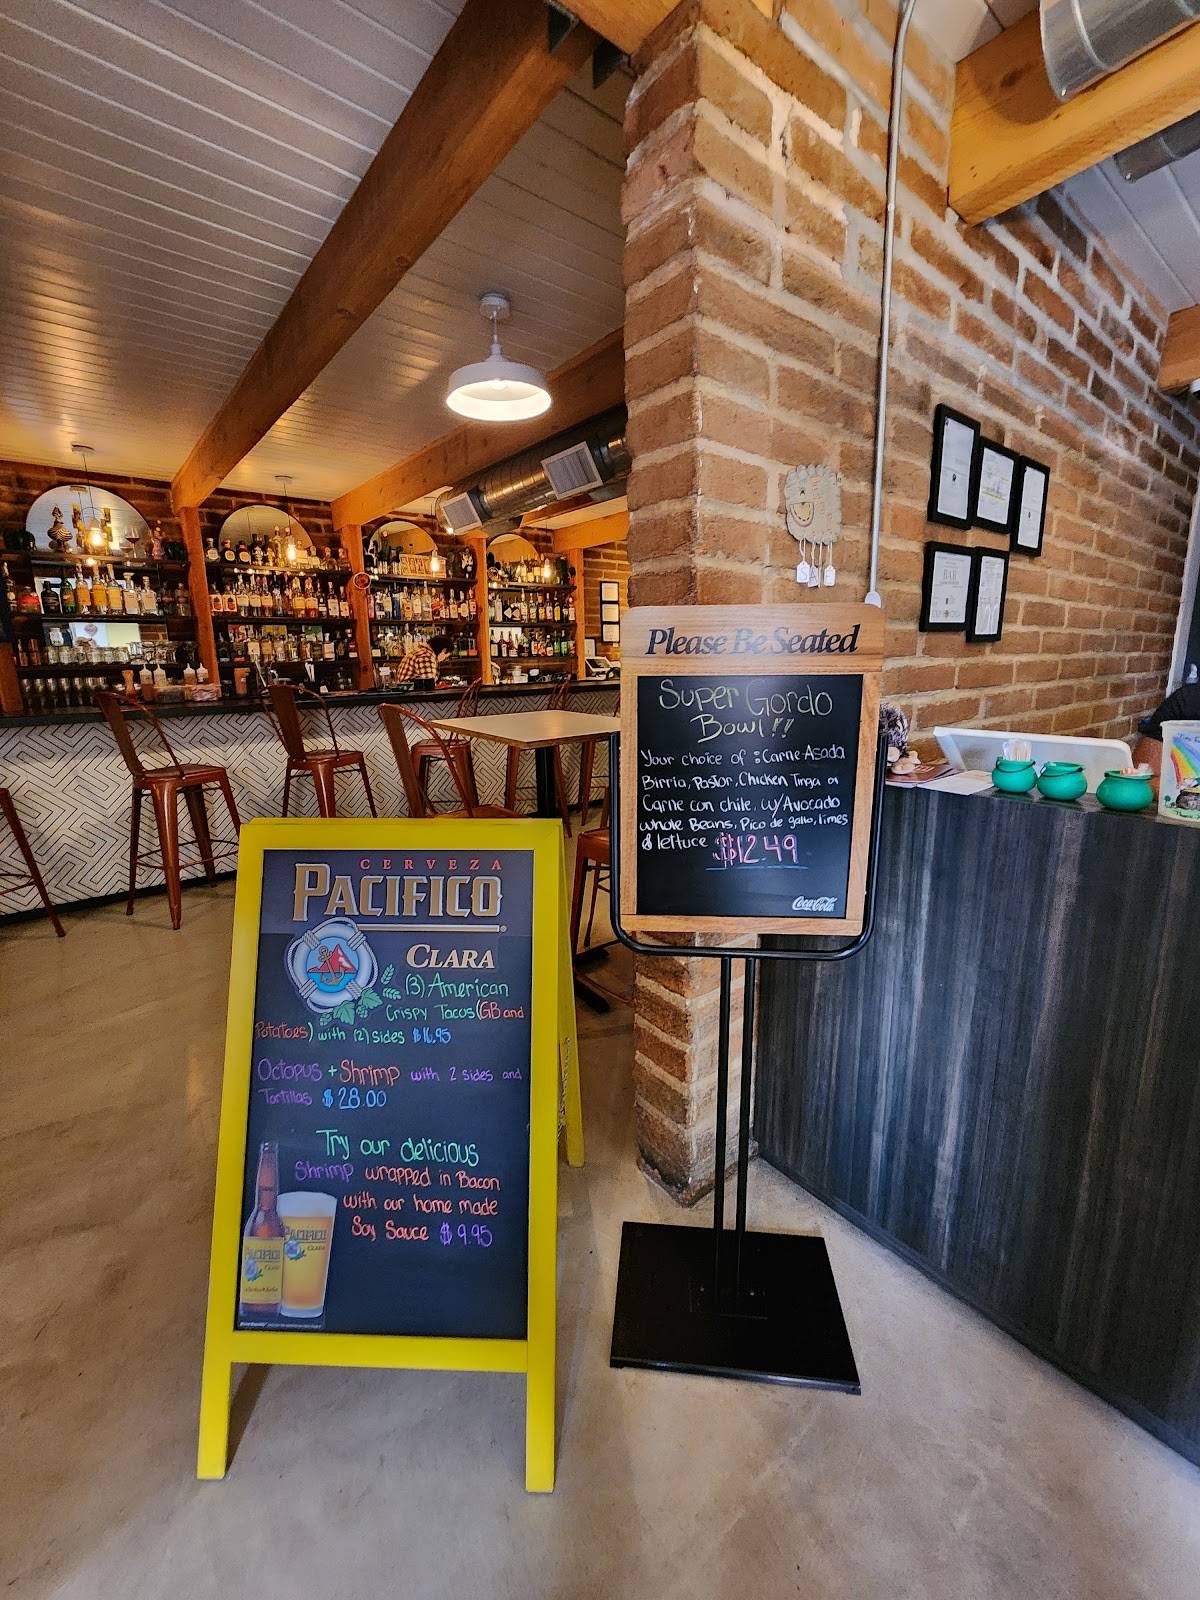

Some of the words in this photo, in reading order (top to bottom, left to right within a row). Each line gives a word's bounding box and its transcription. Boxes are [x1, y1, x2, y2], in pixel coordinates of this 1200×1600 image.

[645, 627, 728, 655] Please
[731, 628, 769, 655] Be
[772, 623, 861, 654] Seated
[659, 679, 740, 712] Super
[746, 681, 833, 717] Gordo
[640, 749, 675, 767] Your
[681, 752, 723, 766] choice
[730, 750, 746, 766] of
[642, 795, 685, 813] Carne
[689, 800, 715, 812] con
[639, 818, 684, 832] whole
[740, 816, 767, 832] Pico
[770, 818, 784, 829] de
[657, 833, 709, 850] lettuce
[359, 859, 503, 871] CERVEZA
[293, 863, 503, 922] PACIFICO
[406, 944, 496, 969] CLARA
[427, 972, 510, 998] American
[385, 1004, 428, 1021] Crispy
[503, 1004, 525, 1018] and
[317, 1027, 347, 1041] with
[257, 1058, 323, 1082] Octopus
[339, 1059, 401, 1087] Shrimp
[410, 1067, 440, 1081] with
[449, 1066, 457, 1081] 2
[461, 1067, 494, 1082] sides
[502, 1069, 523, 1081] and
[257, 1087, 313, 1106] Tortillas
[316, 1129, 350, 1160] Try
[360, 1139, 390, 1156] our
[400, 1137, 480, 1167] delicious
[295, 1161, 354, 1183] Shrimp
[365, 1165, 432, 1188] wrapped
[439, 1170, 452, 1187] in
[456, 1171, 501, 1191] Bacon
[343, 1191, 378, 1210] with
[384, 1197, 406, 1210] our
[413, 1194, 453, 1215] home
[458, 1199, 499, 1216] made
[351, 1215, 377, 1242] Soy
[385, 1219, 430, 1241] Sauce
